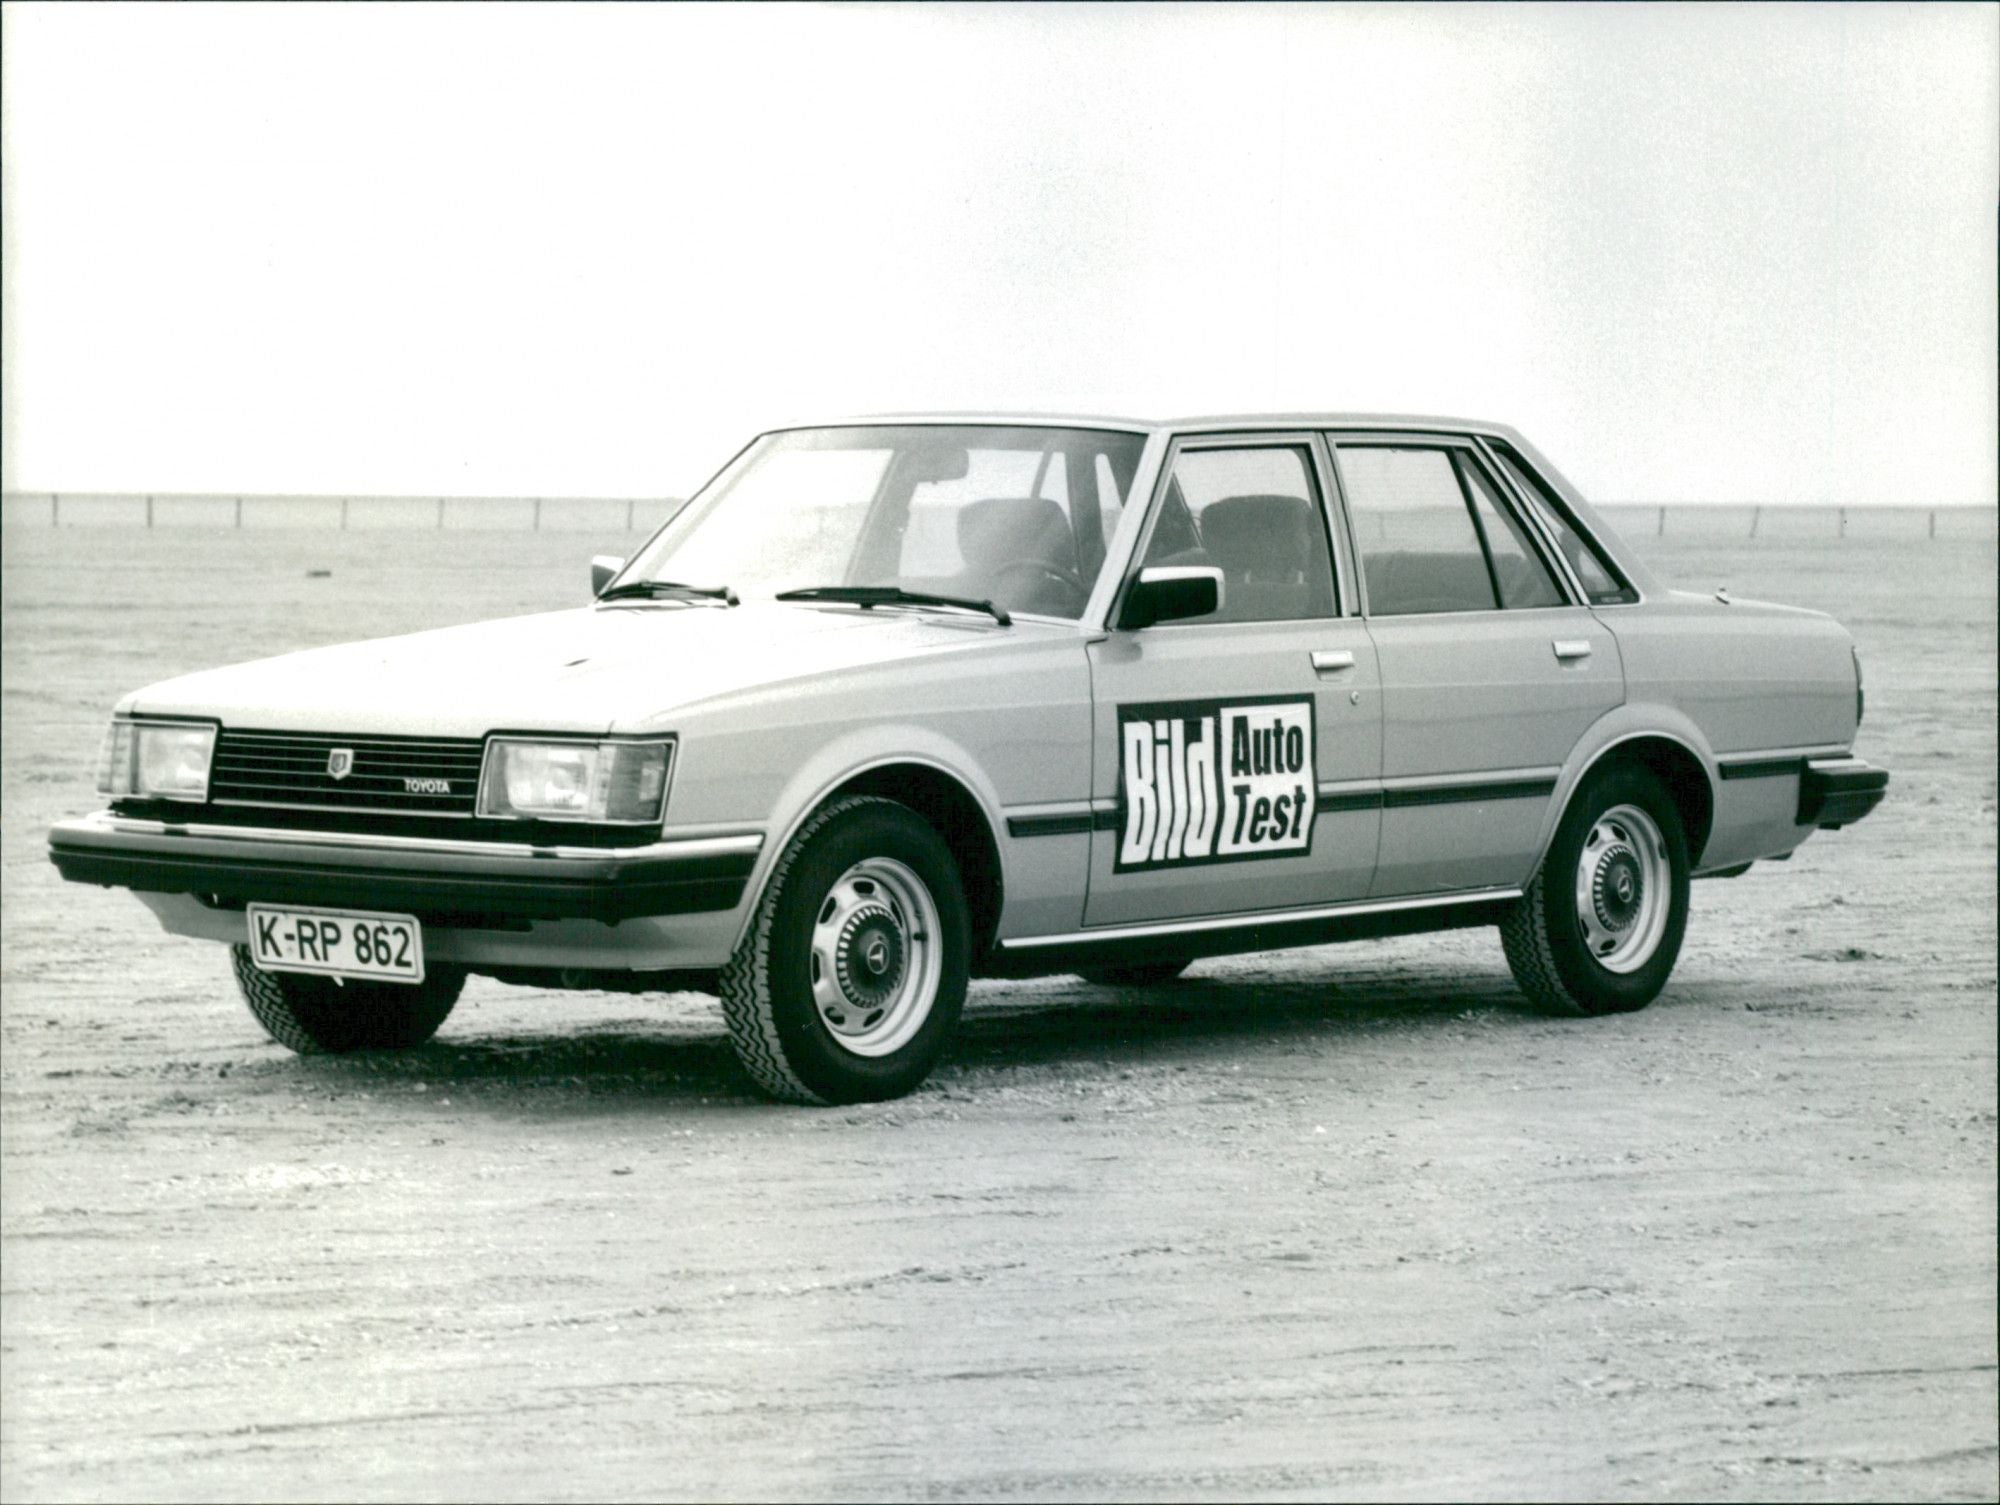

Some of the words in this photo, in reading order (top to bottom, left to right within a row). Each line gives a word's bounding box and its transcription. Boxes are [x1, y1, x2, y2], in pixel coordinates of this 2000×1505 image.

[1231, 715, 1304, 778] Auto
[404, 778, 450, 793] TOYOTA
[1120, 716, 1219, 865] Bild
[1231, 784, 1307, 845] Test
[257, 915, 341, 962] K-RP
[353, 922, 413, 968] 862
